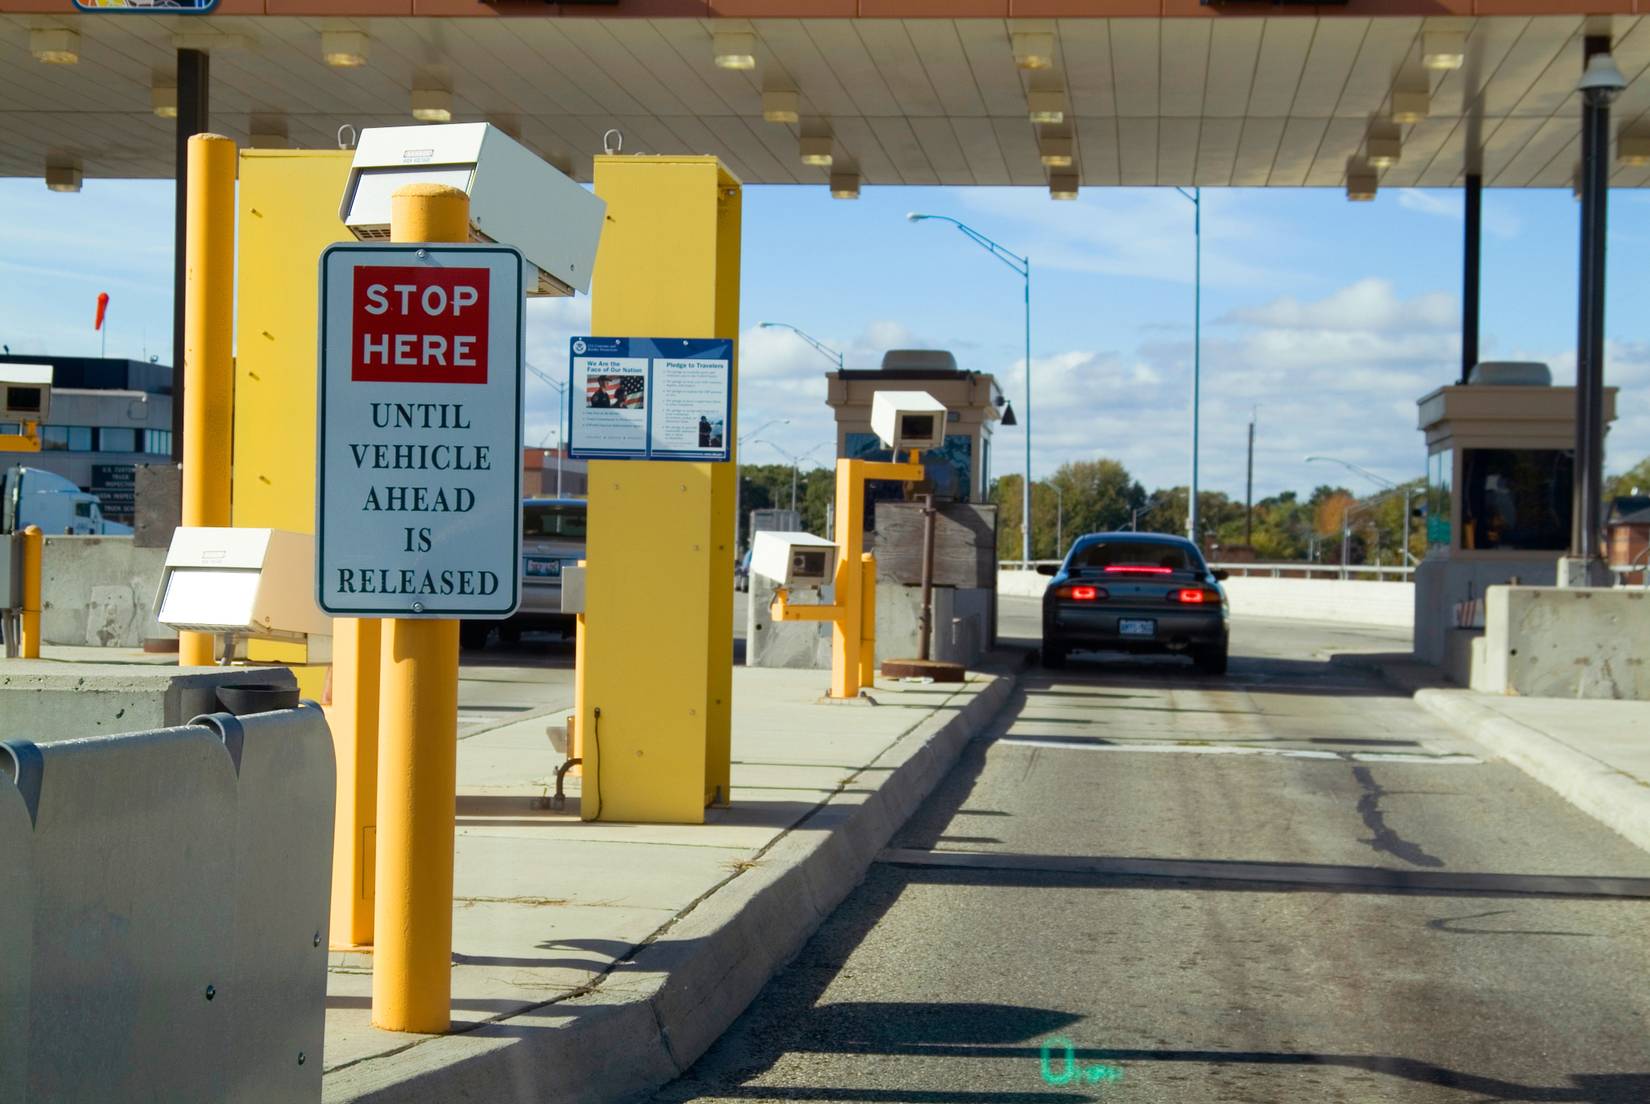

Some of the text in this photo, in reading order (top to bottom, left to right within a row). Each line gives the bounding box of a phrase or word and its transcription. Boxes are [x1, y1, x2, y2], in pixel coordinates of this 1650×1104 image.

[364, 283, 479, 316] STOP
[363, 333, 477, 366] HERE
[666, 361, 687, 369] Pledge
[370, 403, 471, 429] UNTIL
[348, 443, 491, 470] VEHICLE
[362, 486, 475, 512] AHEAD
[404, 527, 432, 552] IS
[337, 568, 499, 596] RELEASED
